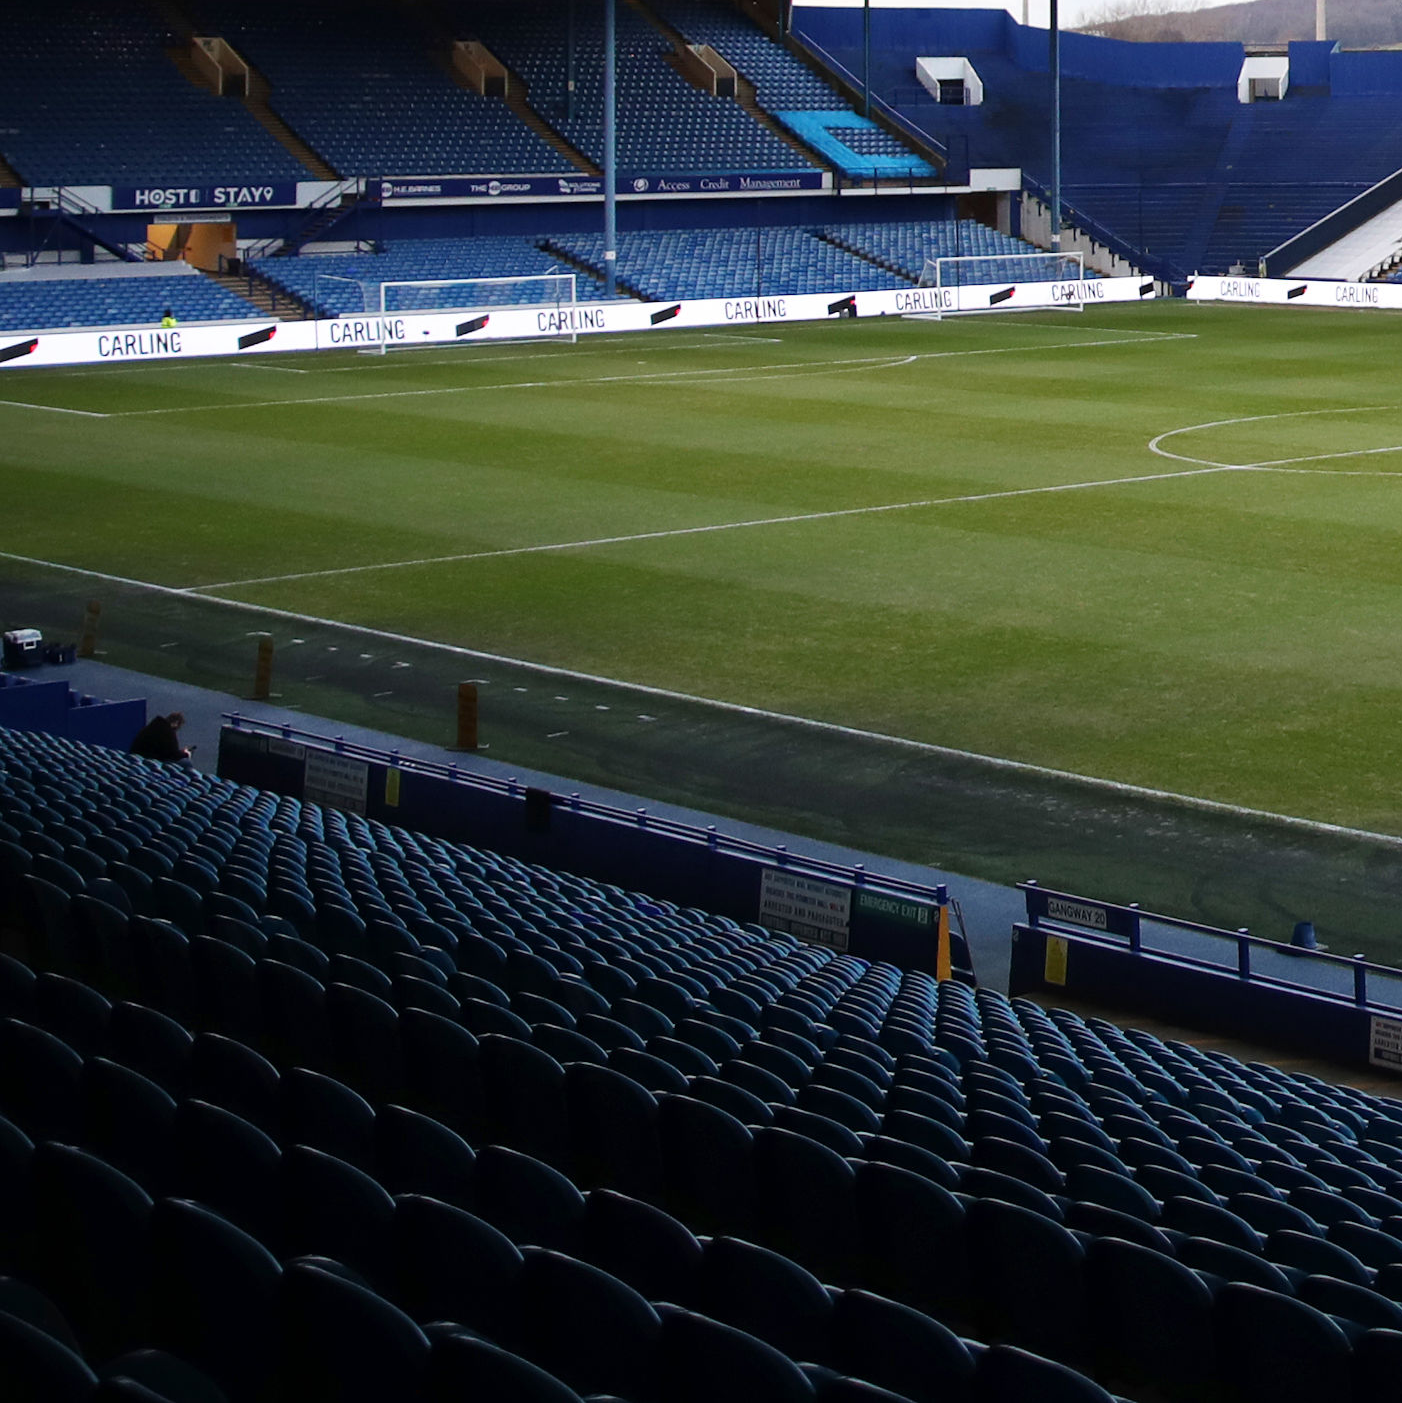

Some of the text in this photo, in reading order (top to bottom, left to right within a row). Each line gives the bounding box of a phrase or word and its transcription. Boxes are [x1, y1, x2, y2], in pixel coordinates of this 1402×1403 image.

[470, 184, 487, 193] THE
[501, 183, 531, 192] GROUP
[657, 176, 801, 193] Access Credit Management
[213, 187, 263, 204] STAY
[1220, 281, 1260, 298] CARLING
[1335, 286, 1378, 303] CARLING
[725, 300, 787, 320] CARLING
[895, 290, 952, 311] CARLING
[537, 309, 605, 331] CARLING
[330, 319, 405, 343] CARLING
[98, 332, 181, 356] CARLING
[860, 893, 917, 918] EMERGENCY EXIT
[1049, 901, 1105, 925] GANGWAY 20
